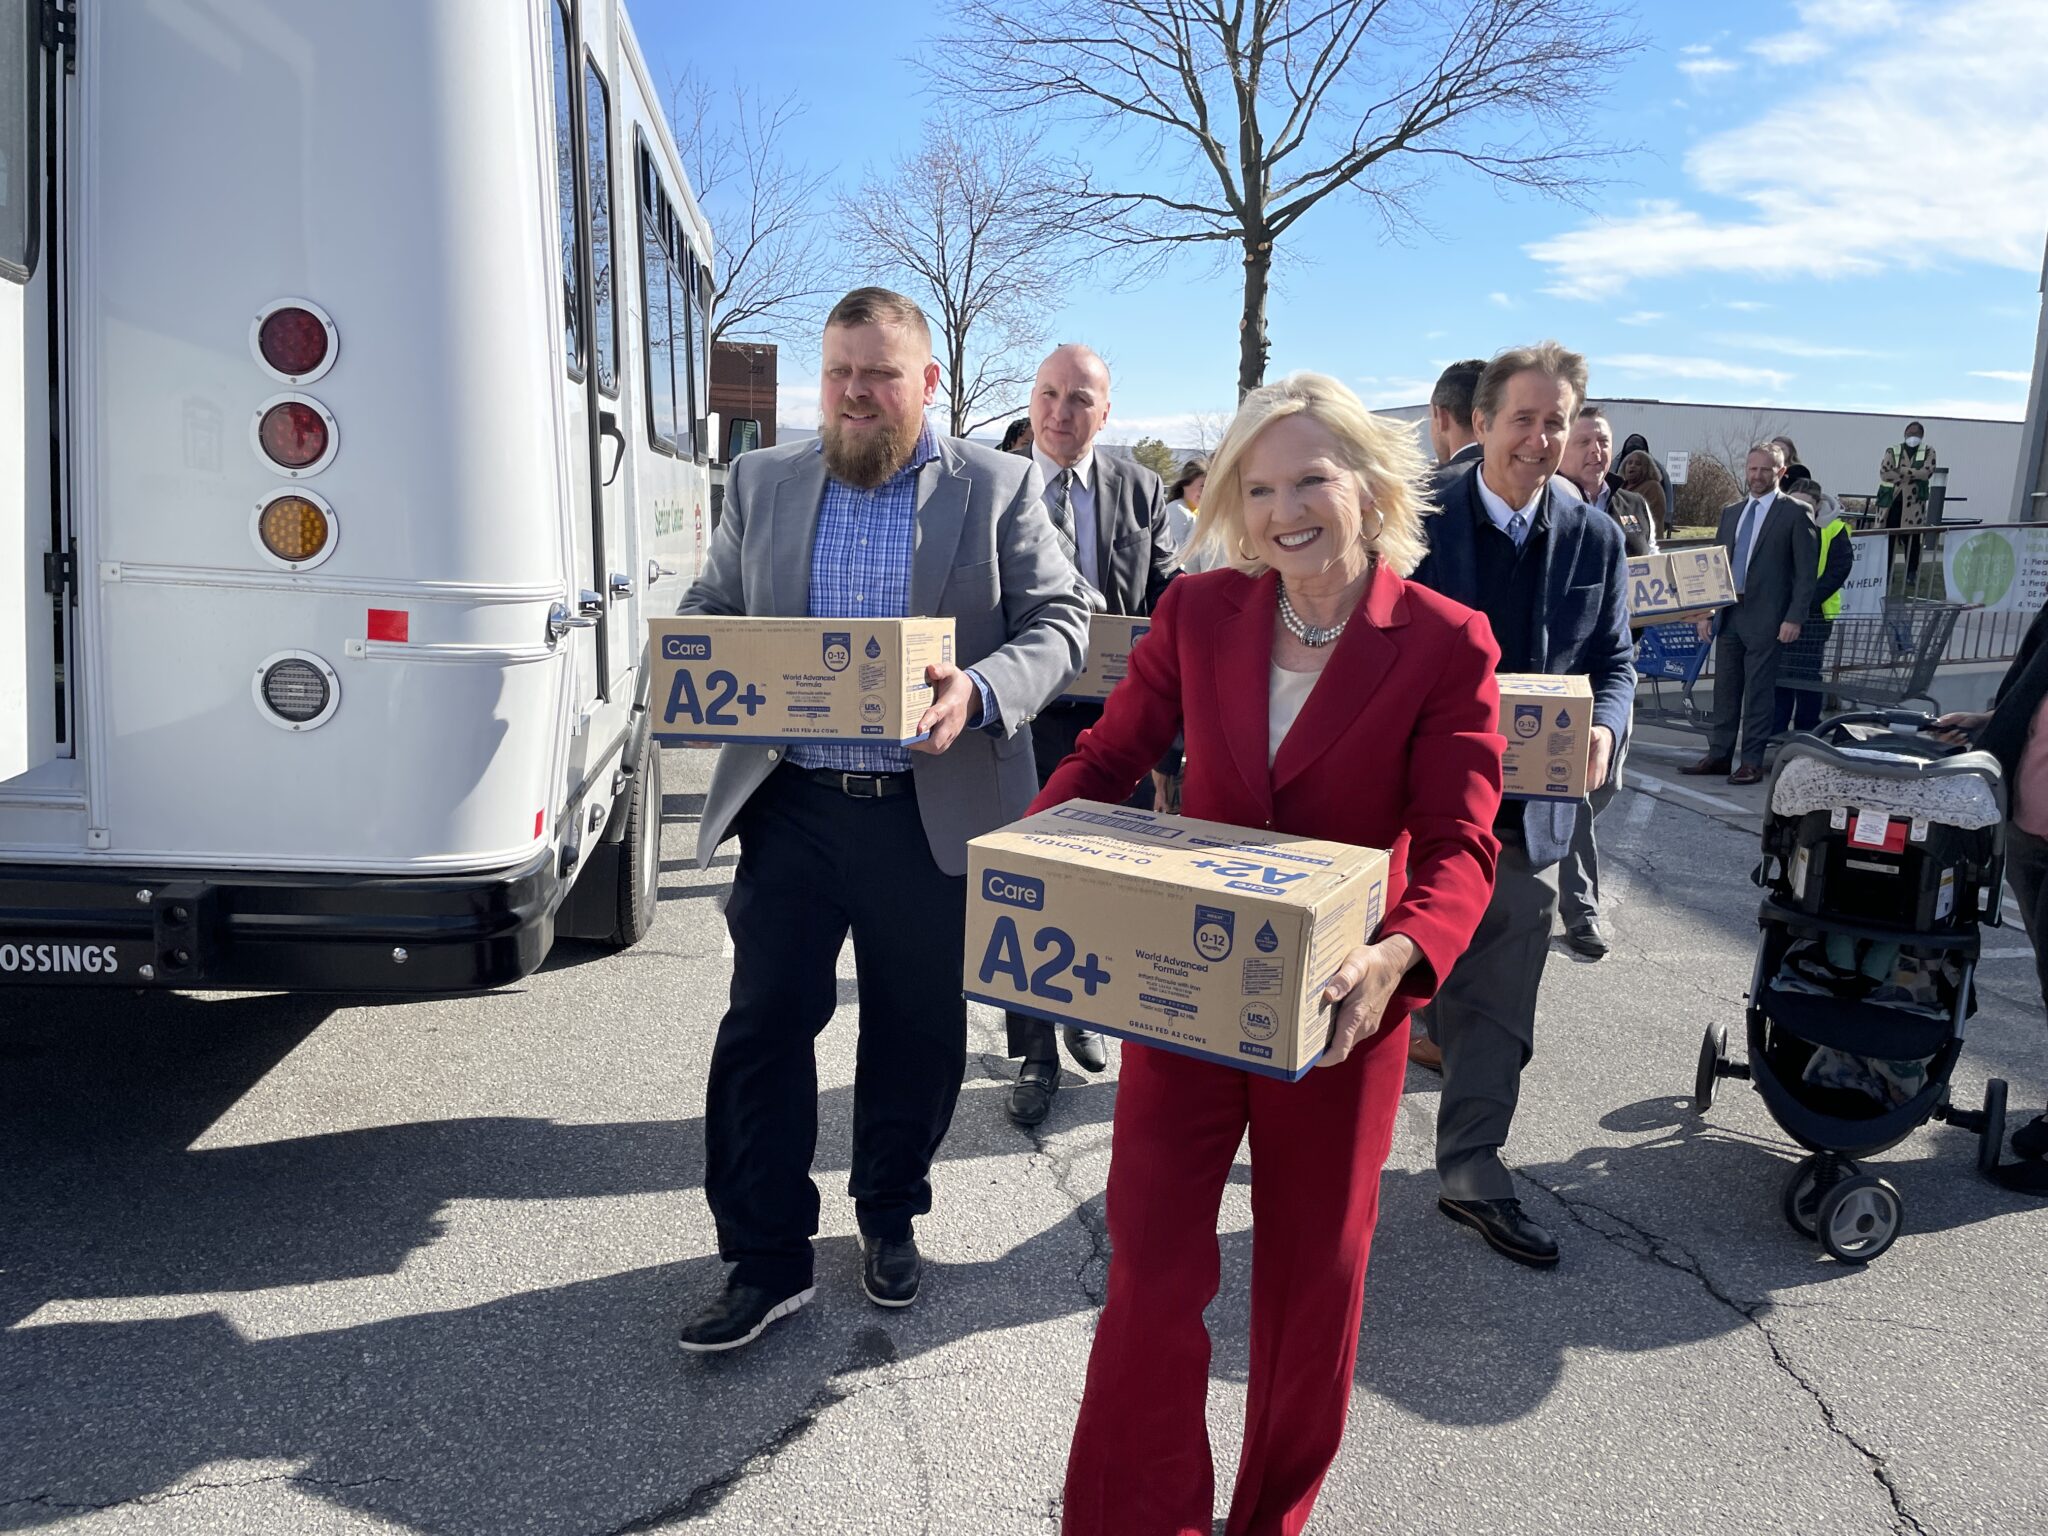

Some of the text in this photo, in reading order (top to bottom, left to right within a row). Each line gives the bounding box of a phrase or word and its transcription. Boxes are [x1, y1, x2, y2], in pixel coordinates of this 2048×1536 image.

[1856, 577, 1882, 588] HELP!
[667, 640, 706, 656] Care
[664, 669, 766, 725] A2+
[864, 703, 881, 711] USA
[1024, 835, 1102, 856] Months
[1106, 852, 1151, 865] 0-12
[1190, 860, 1310, 885] A2+
[988, 876, 1037, 903] Care
[1233, 882, 1279, 895] Care
[1200, 931, 1225, 946] 0-12
[0, 943, 119, 974] OSSINGS
[979, 915, 1111, 1004] A2+
[1136, 949, 1208, 972] World Advanced
[1153, 963, 1189, 977] Formula
[1247, 1012, 1271, 1026] USA
[1129, 1020, 1207, 1045] GRASS FED A2 COWS
